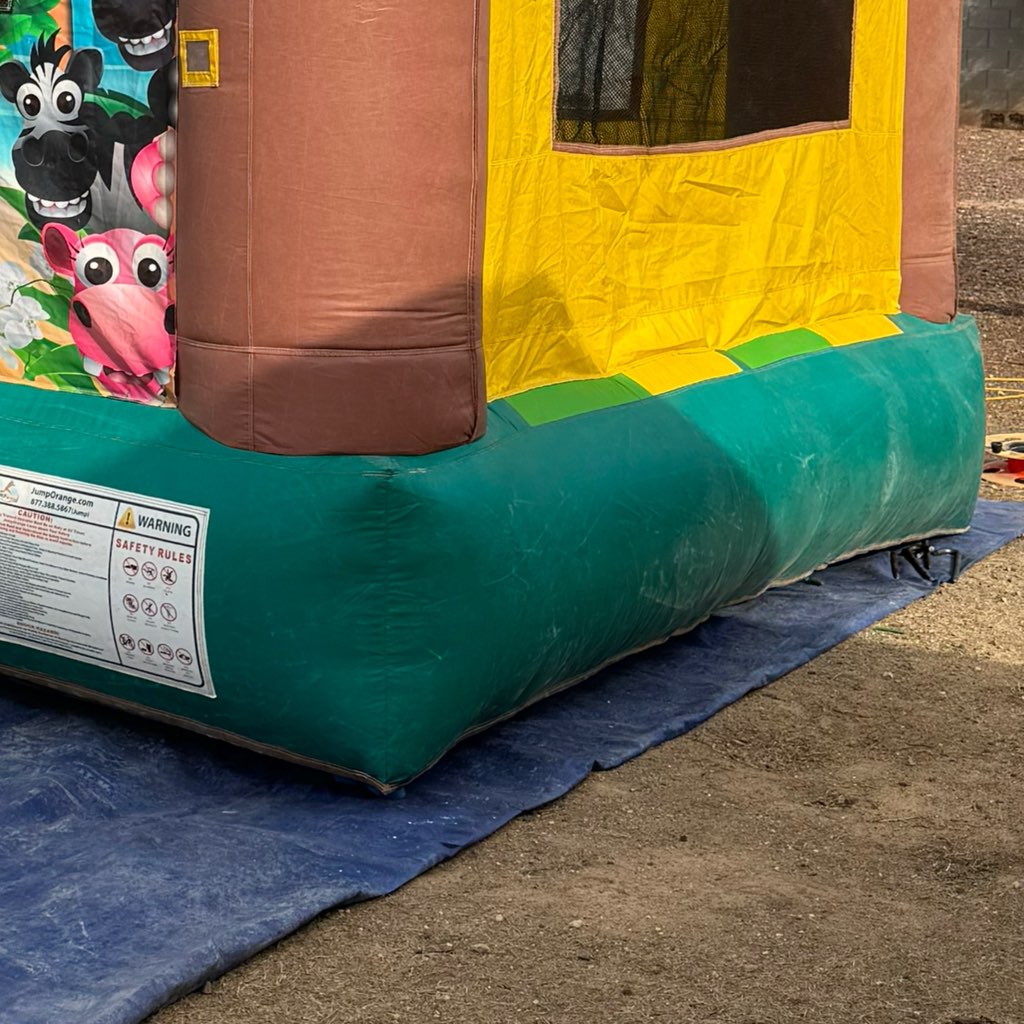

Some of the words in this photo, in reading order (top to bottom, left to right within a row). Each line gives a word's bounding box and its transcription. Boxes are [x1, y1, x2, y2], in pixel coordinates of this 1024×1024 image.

[31, 487, 94, 507] JumpOrange.com
[138, 514, 192, 538] WARNING
[115, 538, 155, 556] SAFETY
[157, 548, 192, 565] RULES
